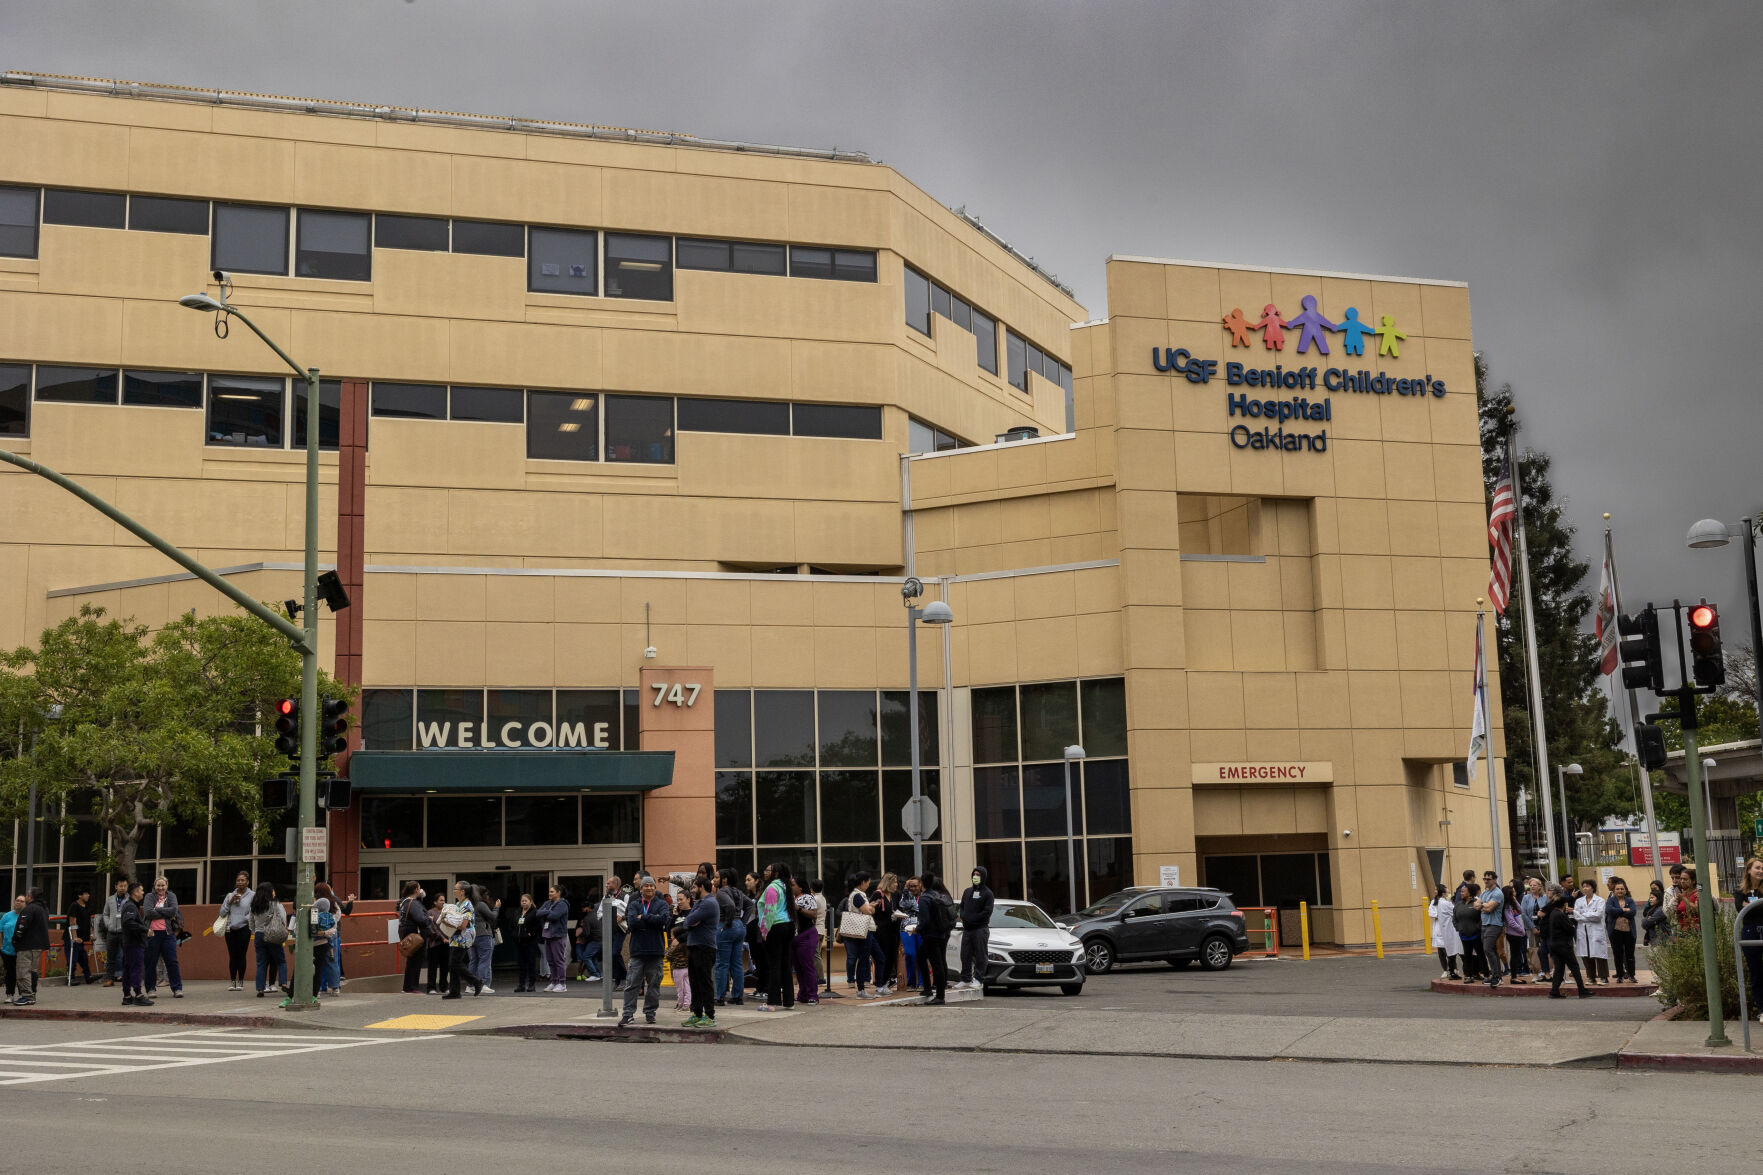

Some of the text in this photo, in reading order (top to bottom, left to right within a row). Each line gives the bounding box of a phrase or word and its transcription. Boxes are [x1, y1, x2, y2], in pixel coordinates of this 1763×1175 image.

[1153, 347, 1447, 398] UCSF Benioff Children's
[1228, 393, 1331, 423] Hospital
[1230, 425, 1327, 452] Oakland
[652, 683, 701, 707] 747
[418, 721, 609, 748] WELCOME
[1219, 766, 1306, 779] EMERGENCY
